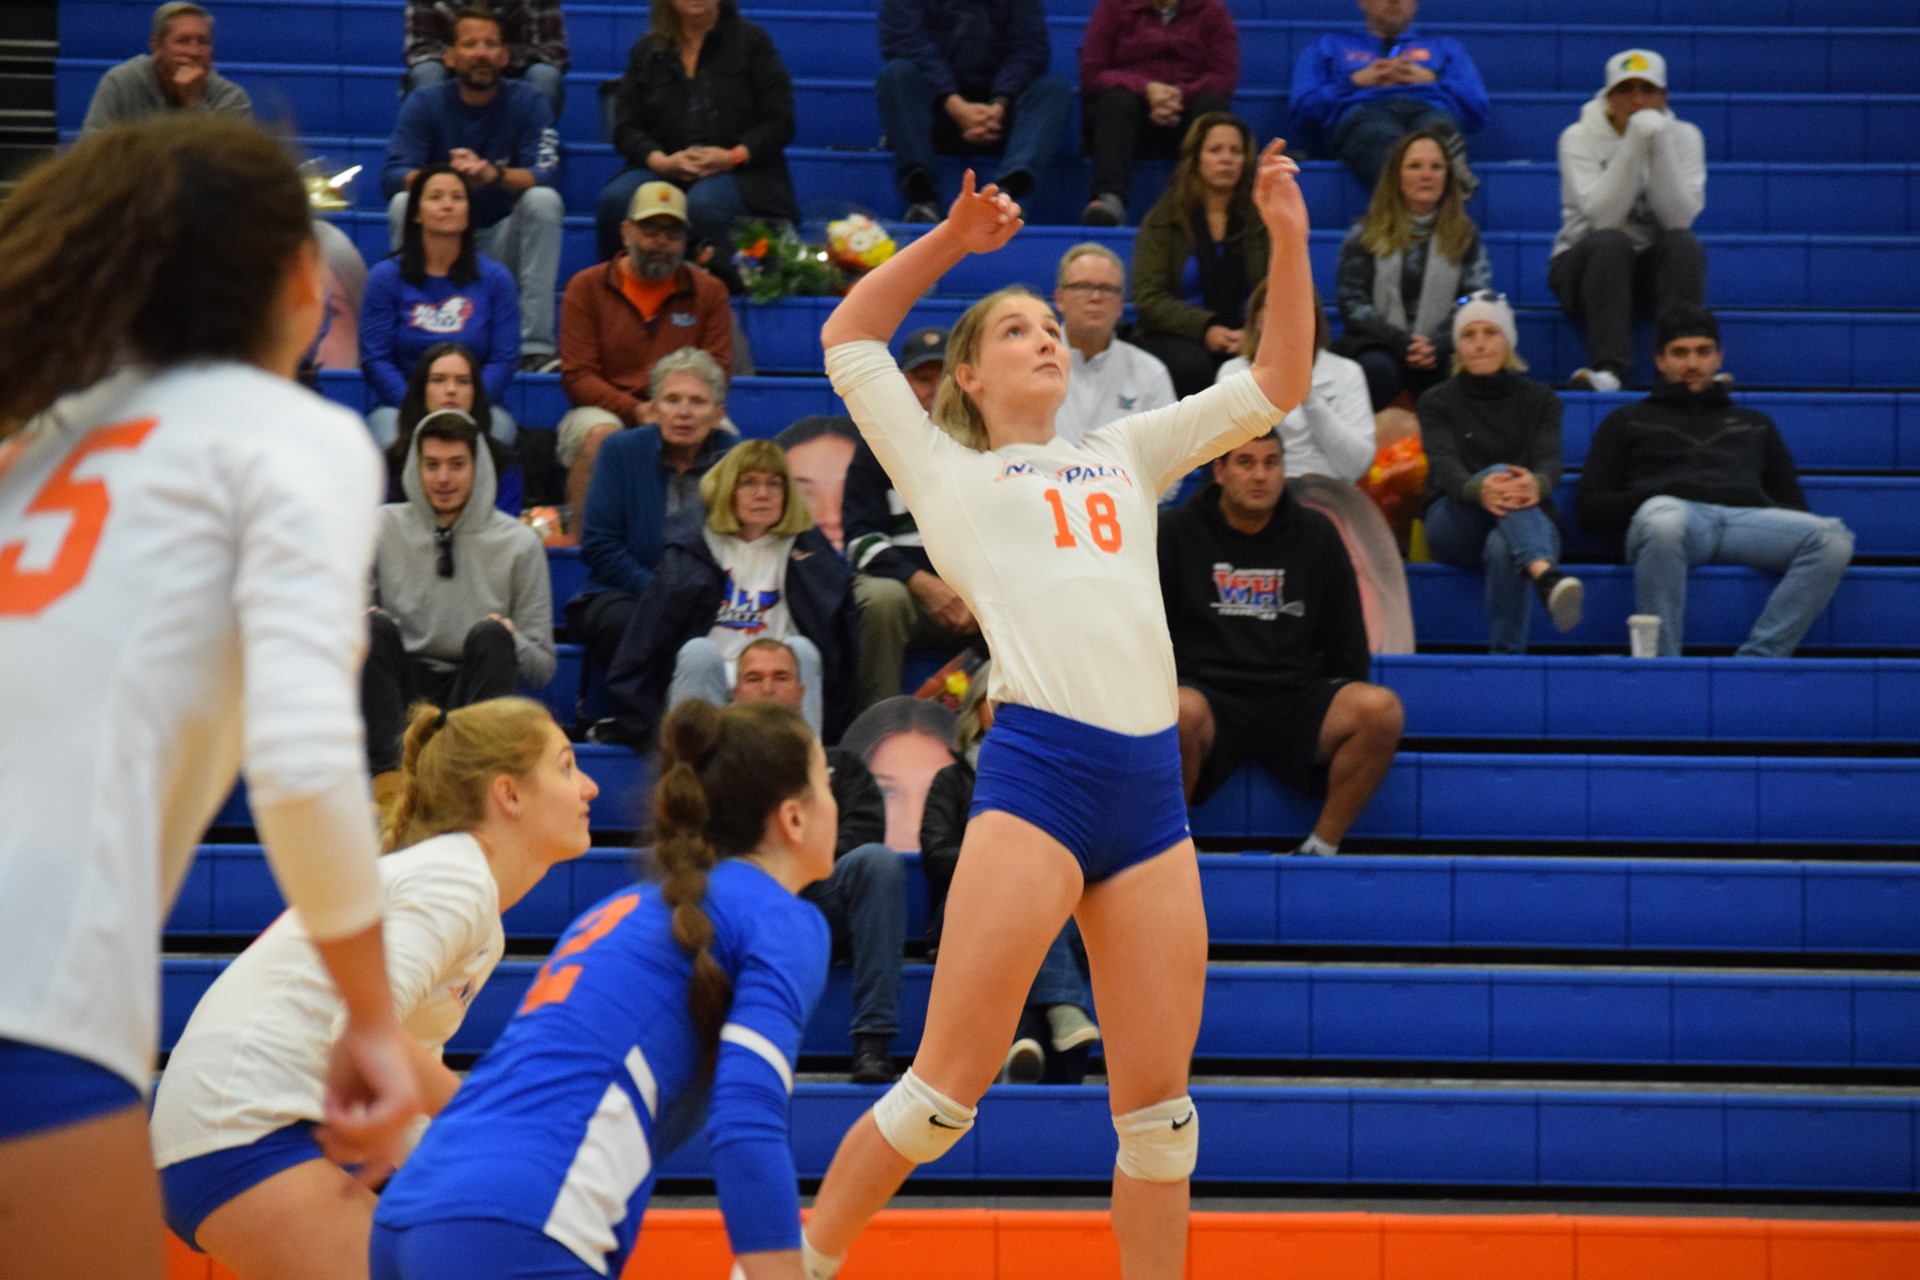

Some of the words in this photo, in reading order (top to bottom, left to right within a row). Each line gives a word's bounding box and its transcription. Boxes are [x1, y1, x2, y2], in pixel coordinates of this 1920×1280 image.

[1043, 488, 1123, 554] 18
[1213, 570, 1284, 607] WH
[517, 893, 641, 1017] 2
